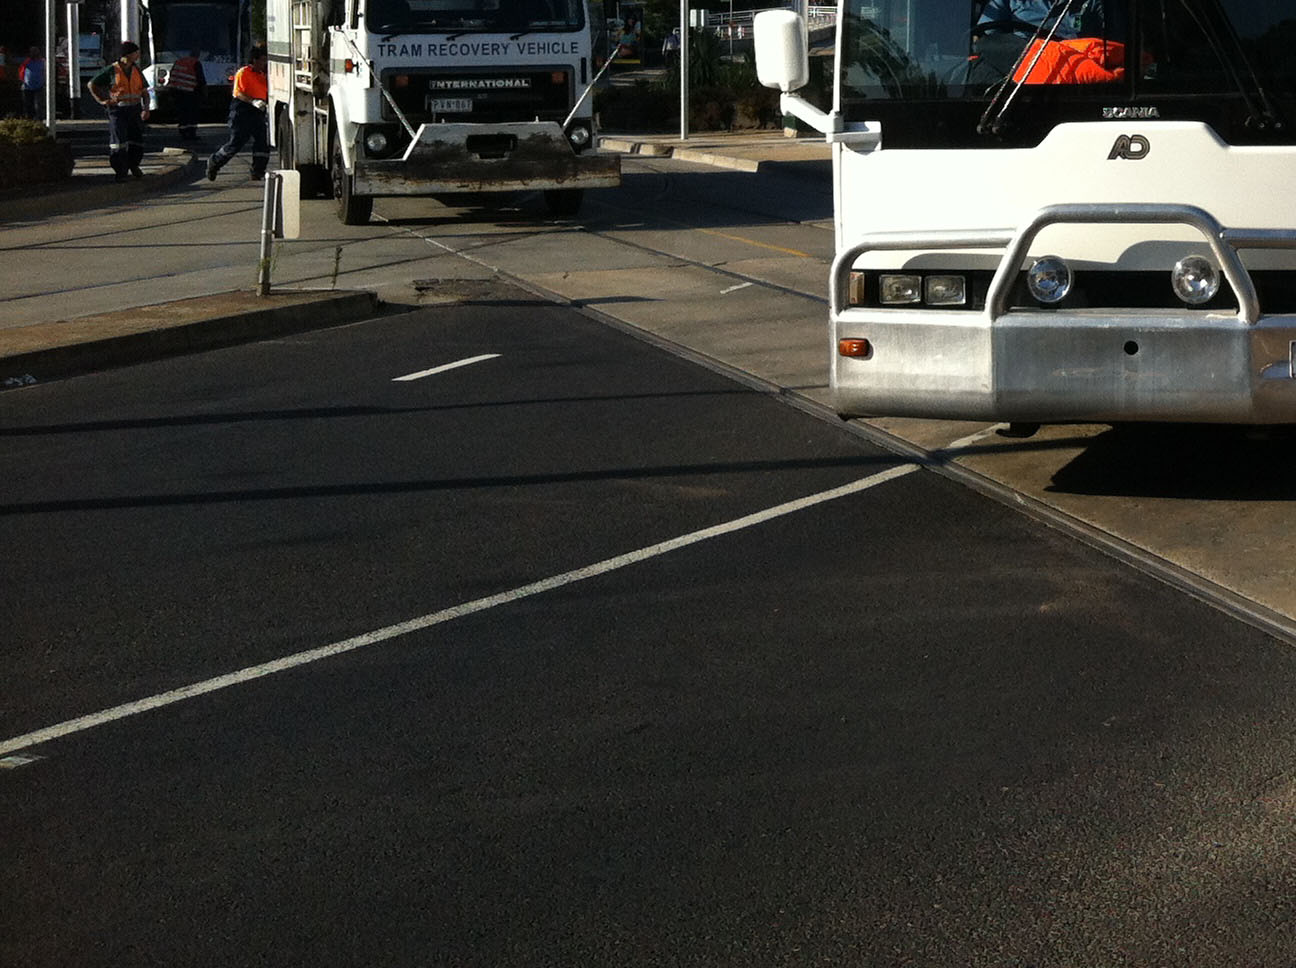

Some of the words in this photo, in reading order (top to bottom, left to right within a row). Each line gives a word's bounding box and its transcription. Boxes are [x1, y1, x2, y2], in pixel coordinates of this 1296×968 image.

[377, 44, 423, 57] TRAM
[427, 43, 511, 57] RECOVERY
[517, 42, 580, 55] VEHICLE
[431, 79, 530, 89] INTERNATIONAL
